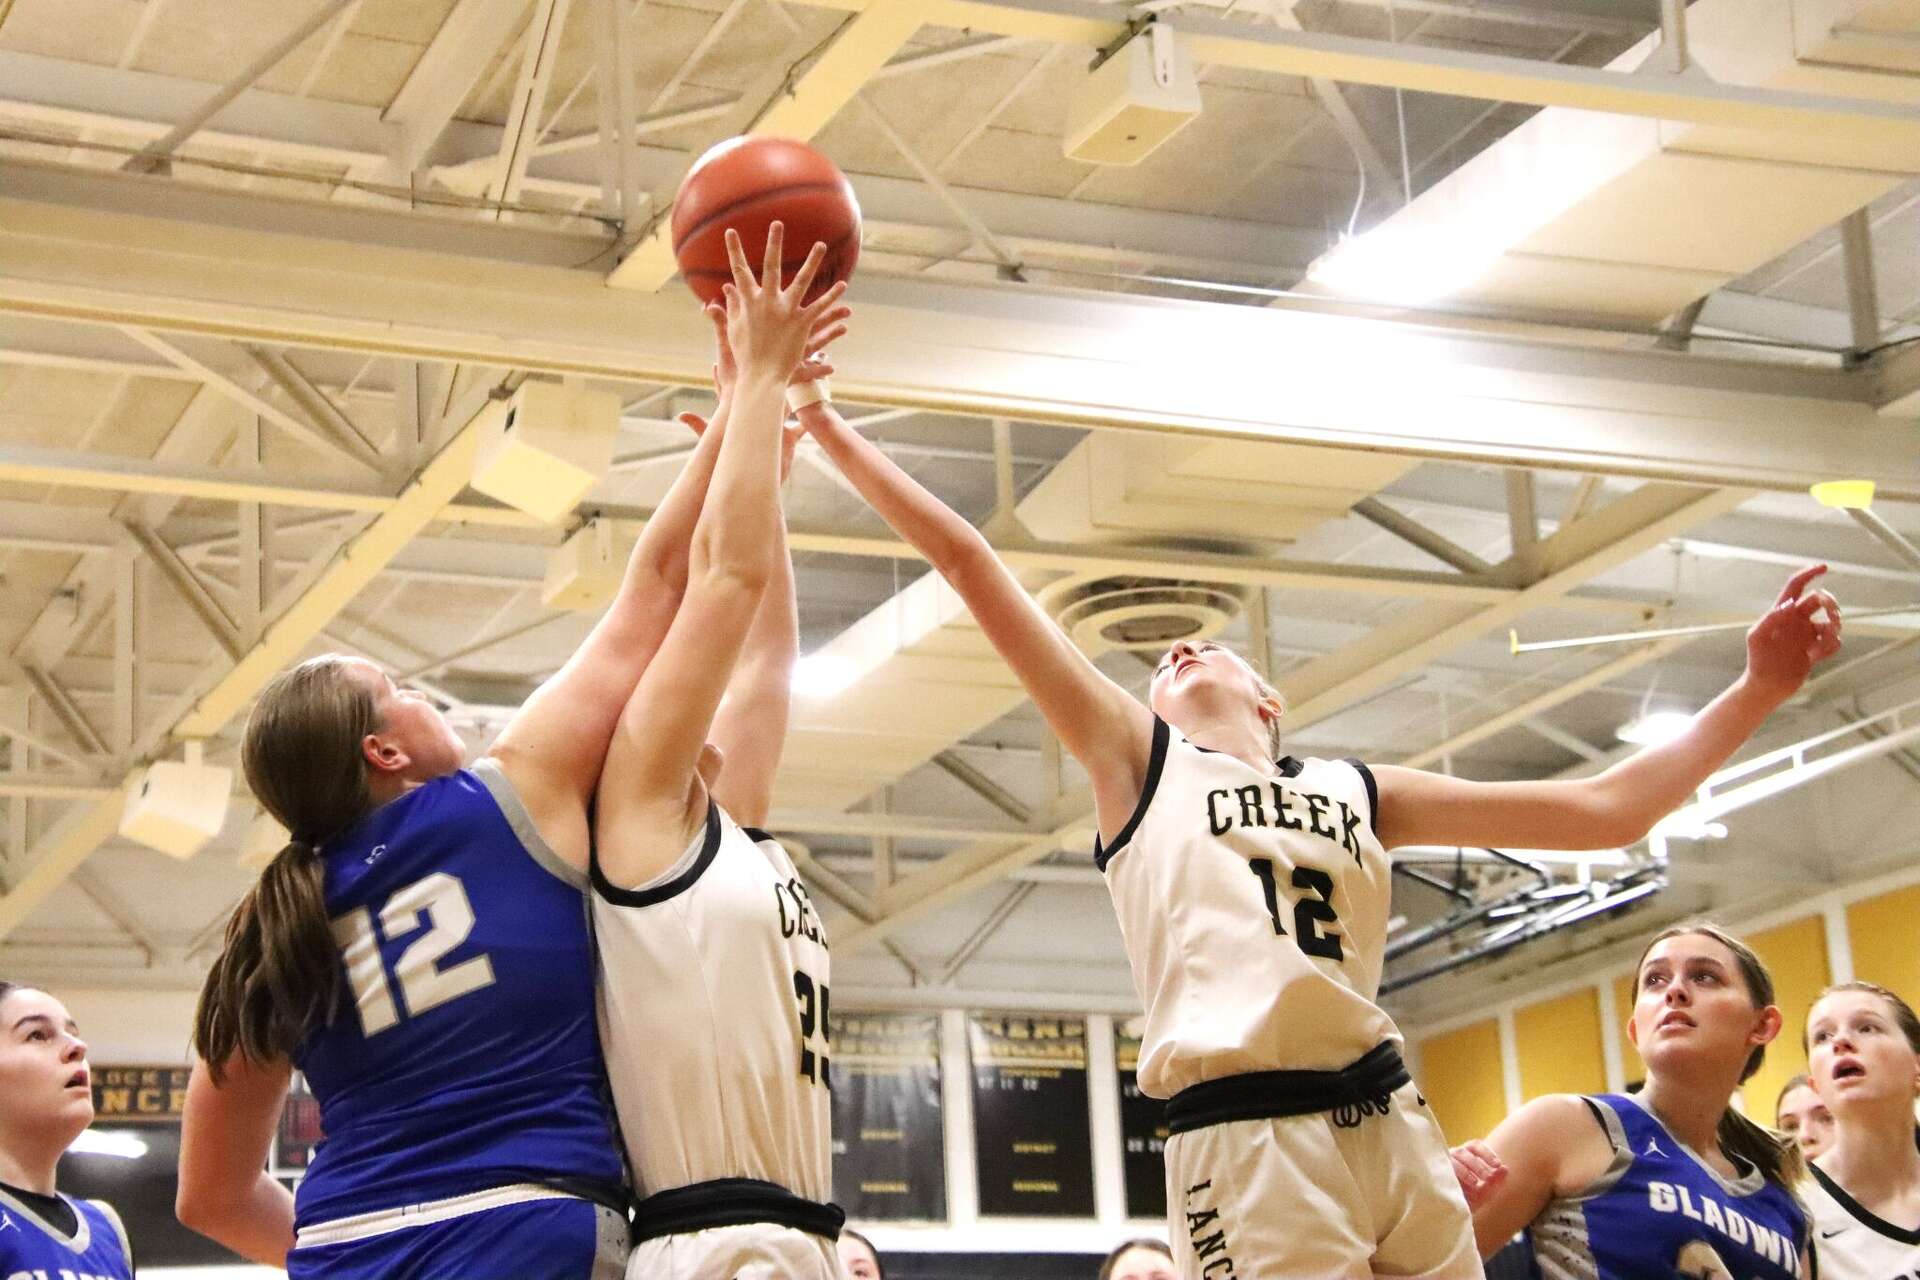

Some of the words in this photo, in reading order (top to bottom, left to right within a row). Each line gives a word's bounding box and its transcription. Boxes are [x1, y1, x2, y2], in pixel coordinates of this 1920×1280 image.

[1207, 768, 1363, 870] CREEK
[328, 871, 497, 1040] 12
[1248, 857, 1344, 962] 12
[793, 969, 830, 1091] 2
